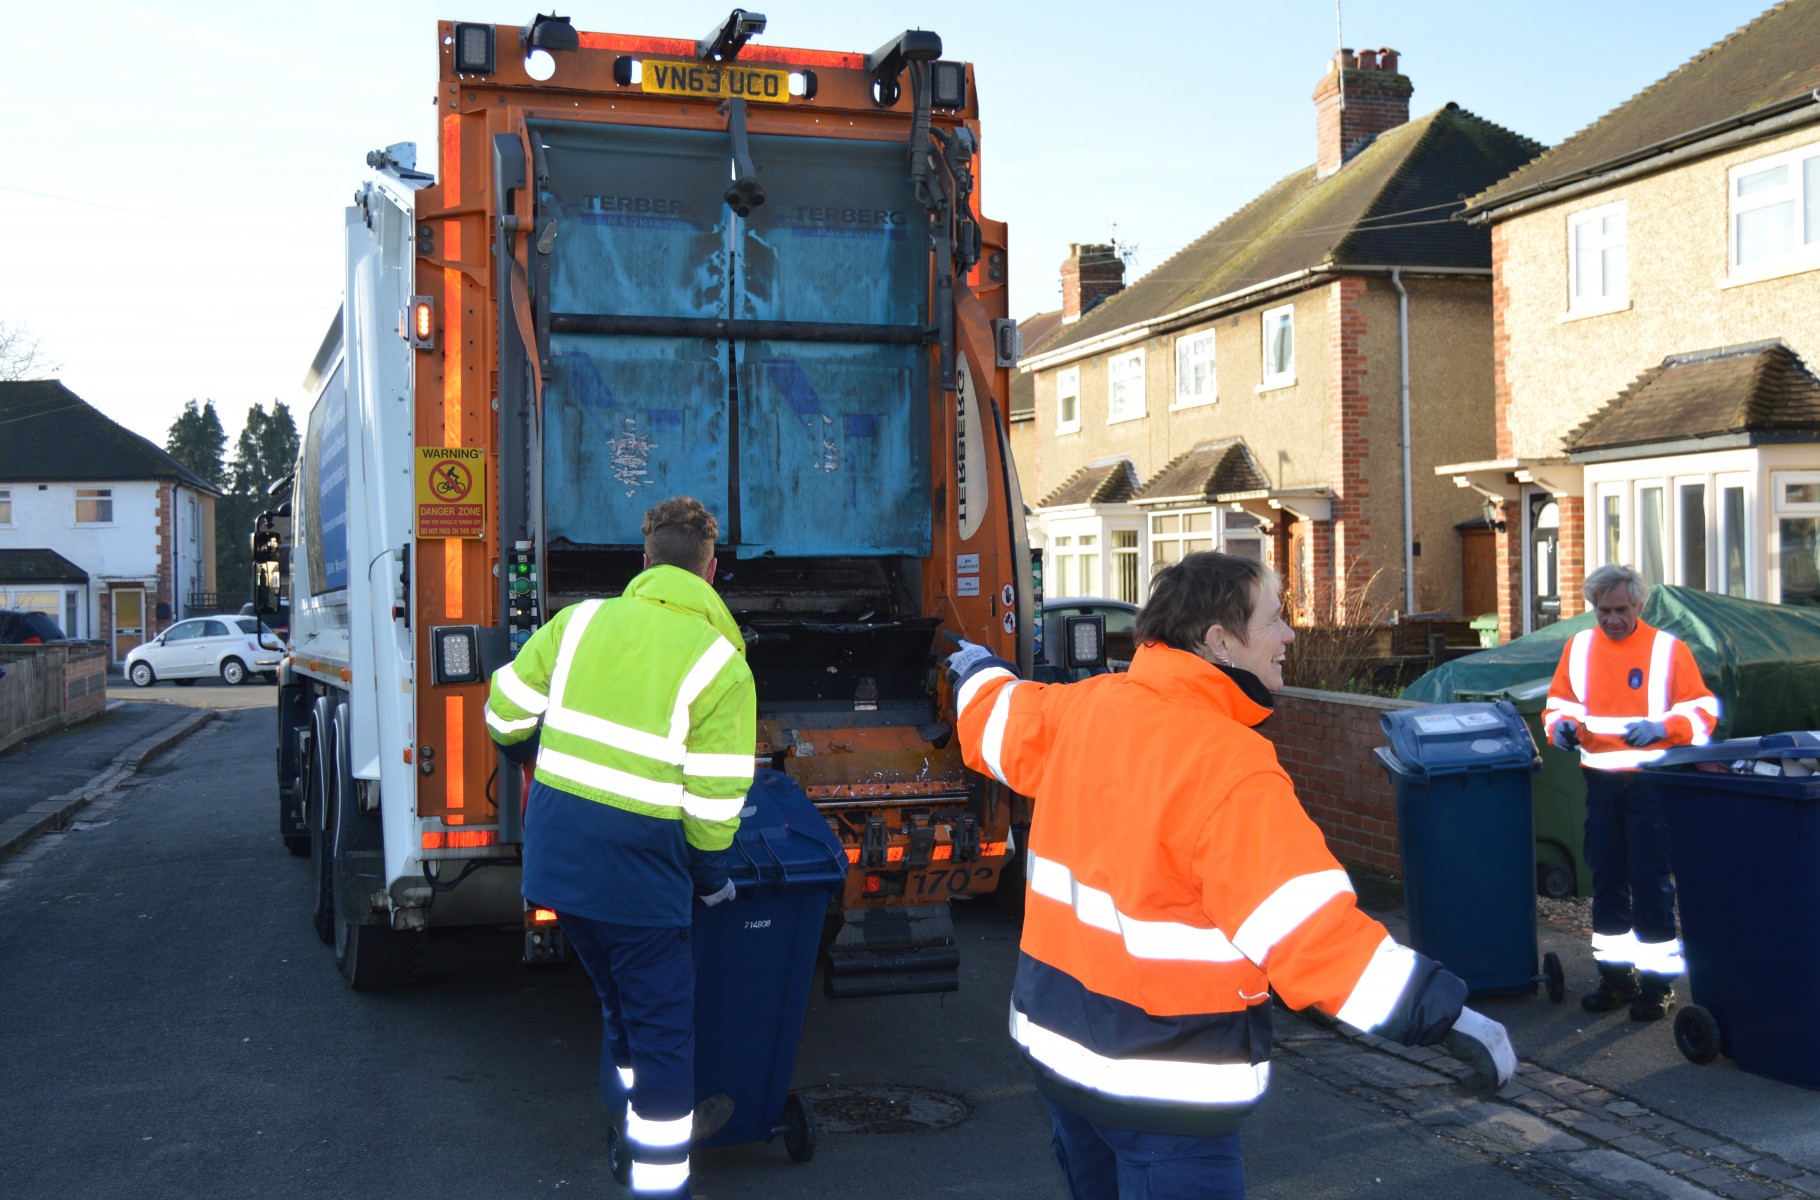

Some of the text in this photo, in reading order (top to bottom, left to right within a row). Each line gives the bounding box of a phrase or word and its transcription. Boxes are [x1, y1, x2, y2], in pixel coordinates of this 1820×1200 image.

[654, 65, 778, 97] VN63 UCO
[793, 206, 906, 226] TERBERG
[422, 448, 479, 459] WARNING
[957, 369, 967, 527] TERBERG
[420, 507, 481, 516] DANGER ZONE
[420, 527, 428, 535] DO
[429, 527, 437, 535] NOT
[439, 527, 450, 535] PASS
[451, 527, 458, 535] ON
[459, 527, 470, 535] THIS
[744, 919, 771, 929] 714908
